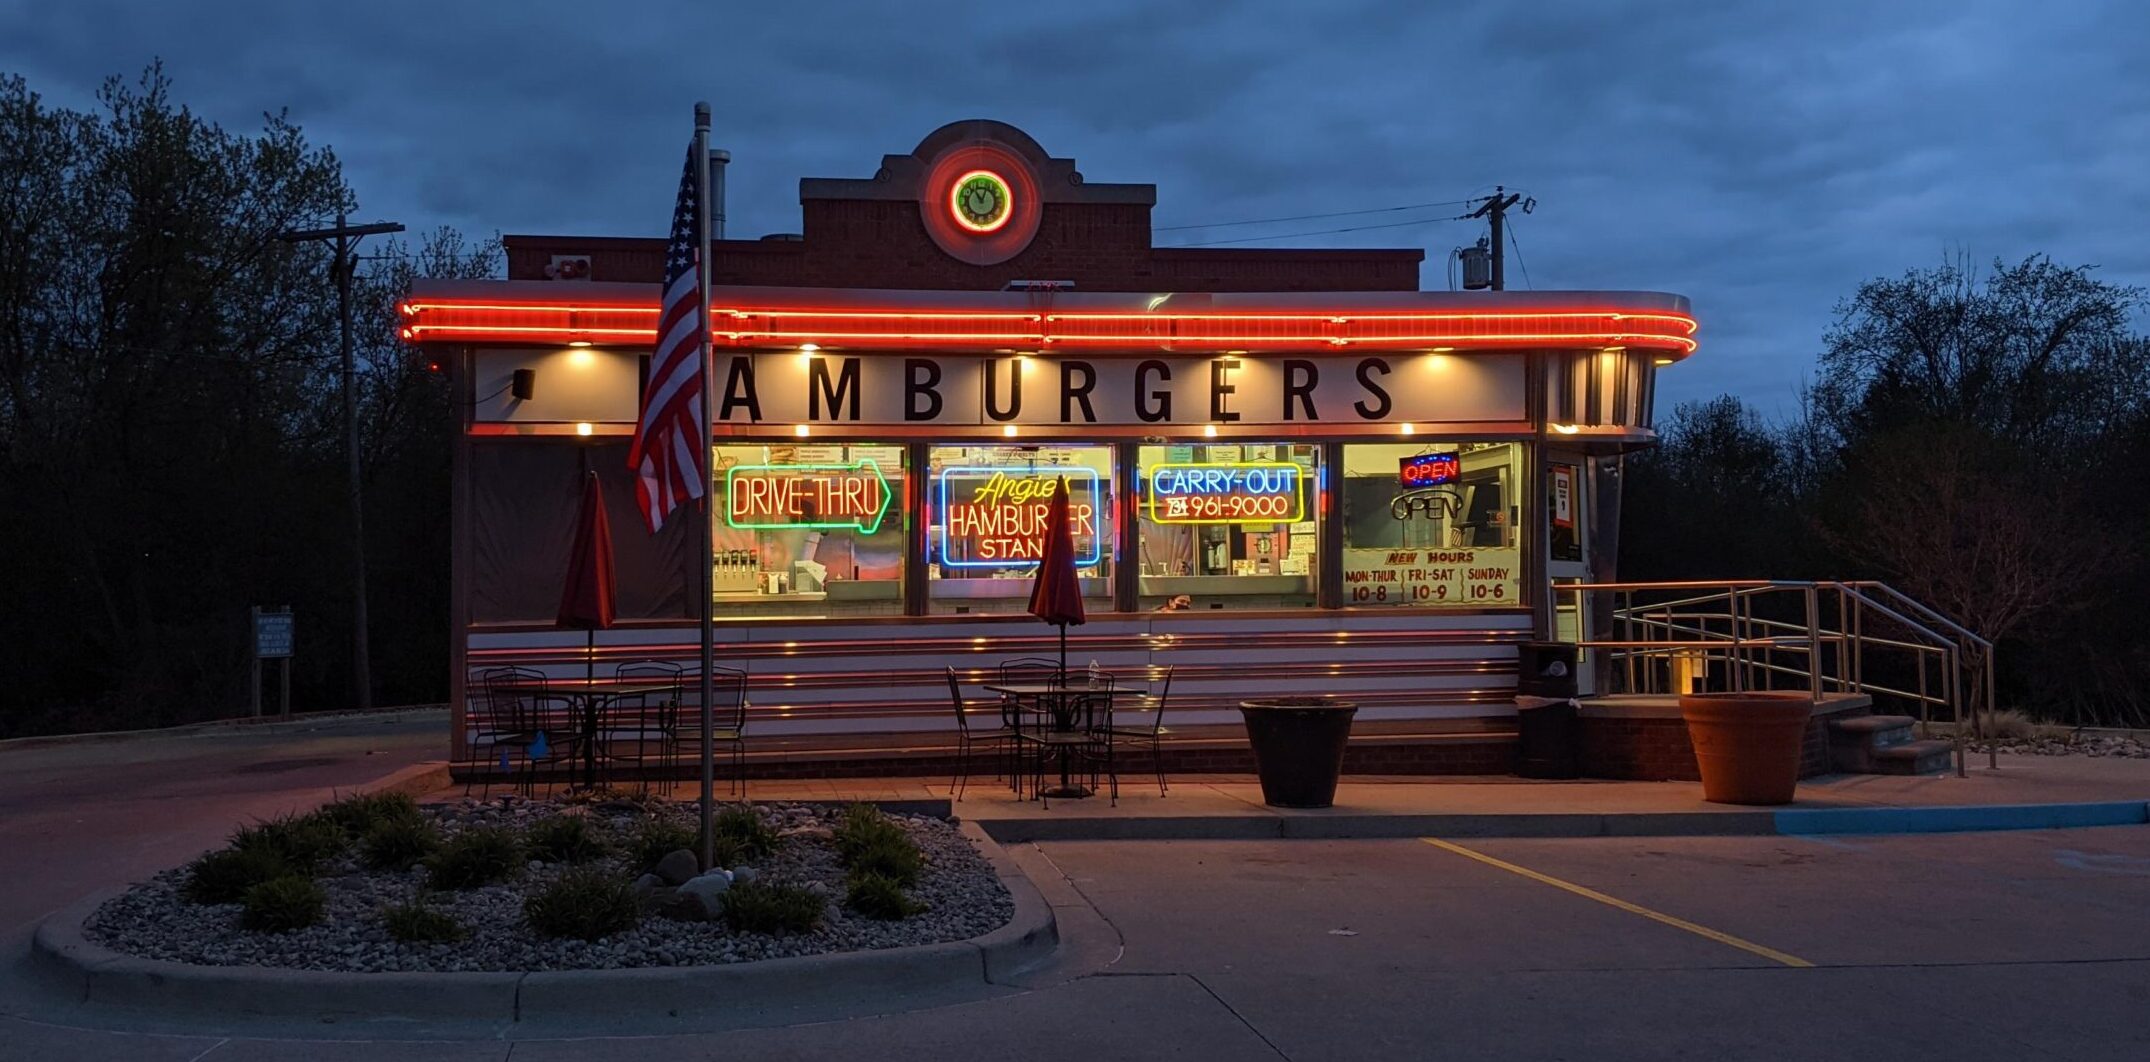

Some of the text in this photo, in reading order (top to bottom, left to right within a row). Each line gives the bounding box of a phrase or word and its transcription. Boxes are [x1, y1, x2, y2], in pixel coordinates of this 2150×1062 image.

[639, 354, 1392, 421] AMBURGERS
[1404, 460, 1459, 480] OPEN
[1155, 469, 1297, 494] CARRY-OUT
[733, 477, 879, 515] DRIVE-THRU
[1191, 496, 1288, 517] 961-9000
[1392, 496, 1460, 520] OPEN
[949, 504, 1094, 536] HAMBURER
[980, 539, 1043, 559] STAN
[1387, 552, 1474, 565] NEW HOURS
[1345, 567, 1509, 583] MON-THUR FRI-SAT SUNDAY
[1353, 583, 1504, 601] 10-8 10-9 10-6
